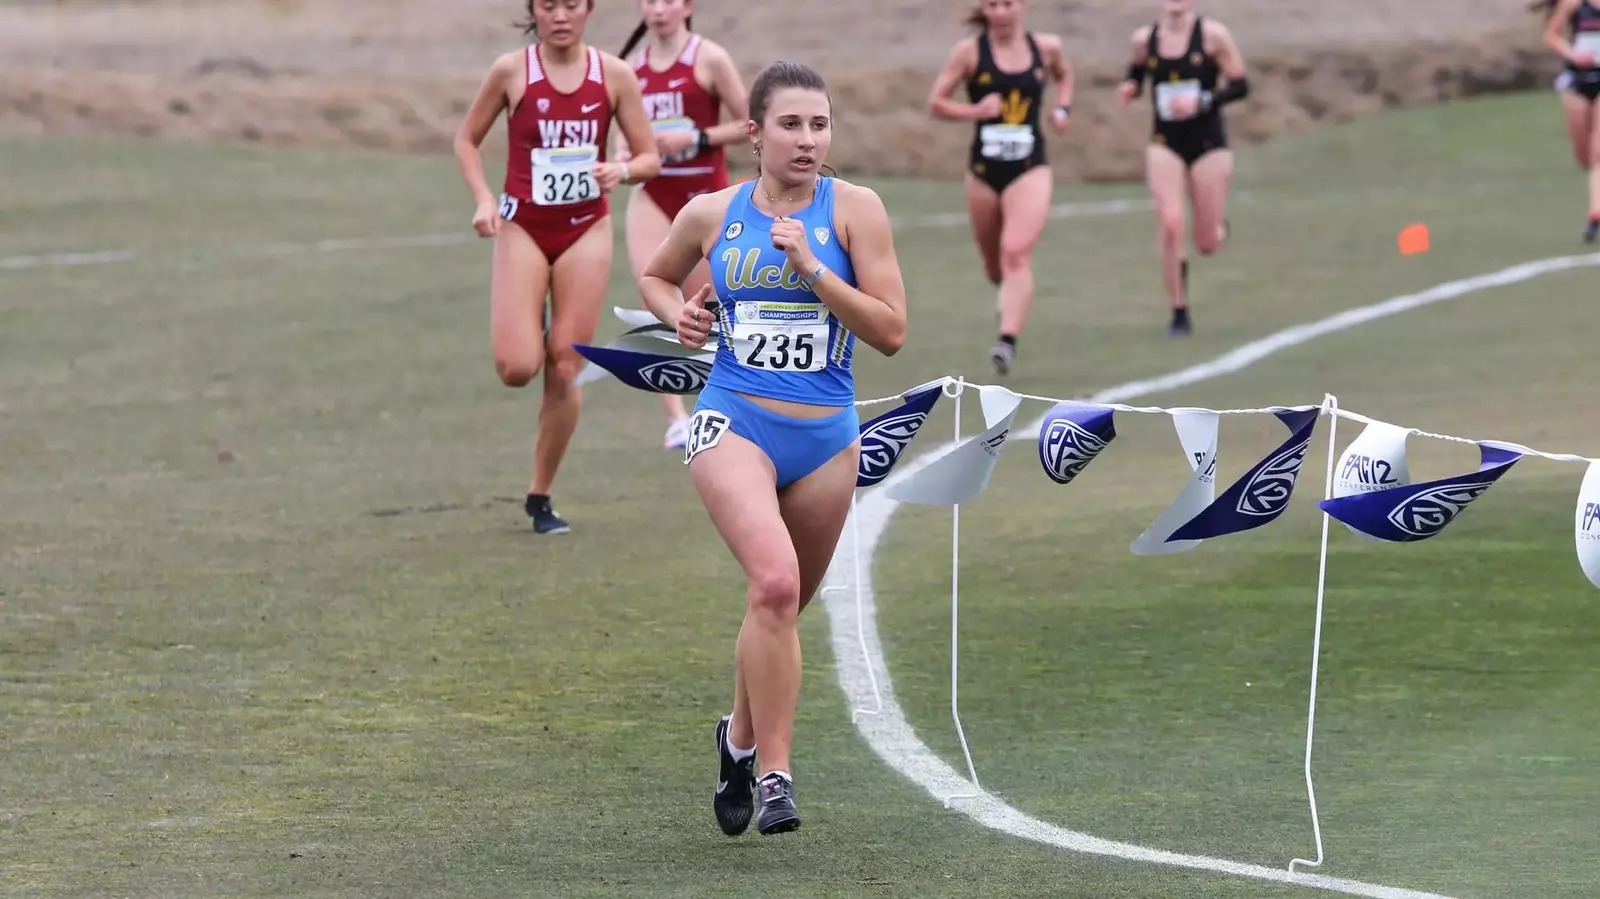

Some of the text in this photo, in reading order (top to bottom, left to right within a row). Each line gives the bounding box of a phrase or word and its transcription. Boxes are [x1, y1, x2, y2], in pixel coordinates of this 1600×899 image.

[538, 119, 598, 148] WSU
[543, 171, 590, 201] 325
[760, 310, 818, 319] CHAMPIONSHIPS
[746, 333, 814, 369] 235
